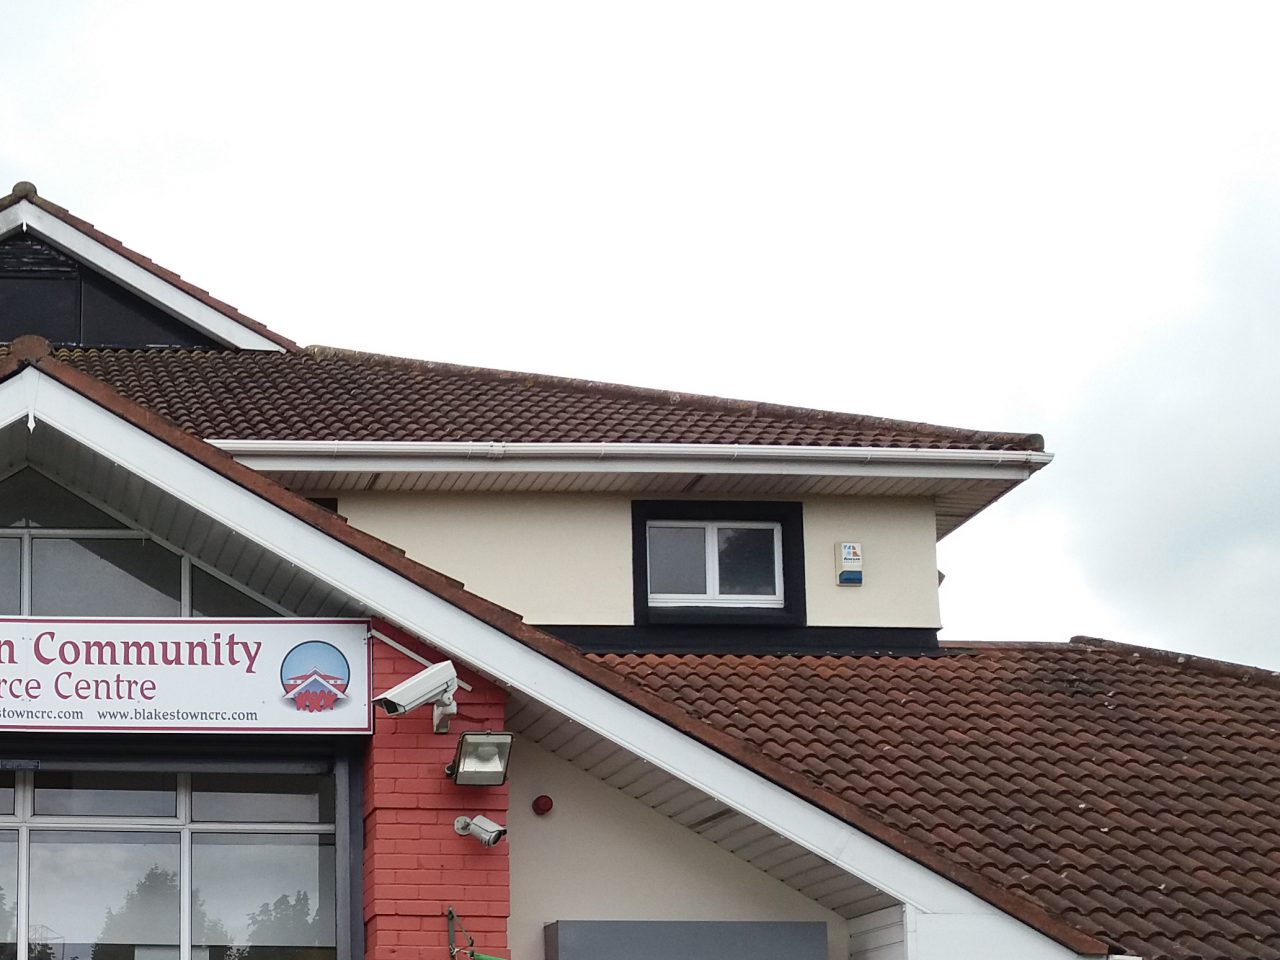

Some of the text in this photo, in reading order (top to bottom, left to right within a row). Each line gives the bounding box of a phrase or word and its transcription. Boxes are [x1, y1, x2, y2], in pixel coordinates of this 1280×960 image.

[33, 631, 262, 673] Community
[54, 671, 157, 700] Centre
[97, 708, 258, 721] www.blakestowncrc.com
